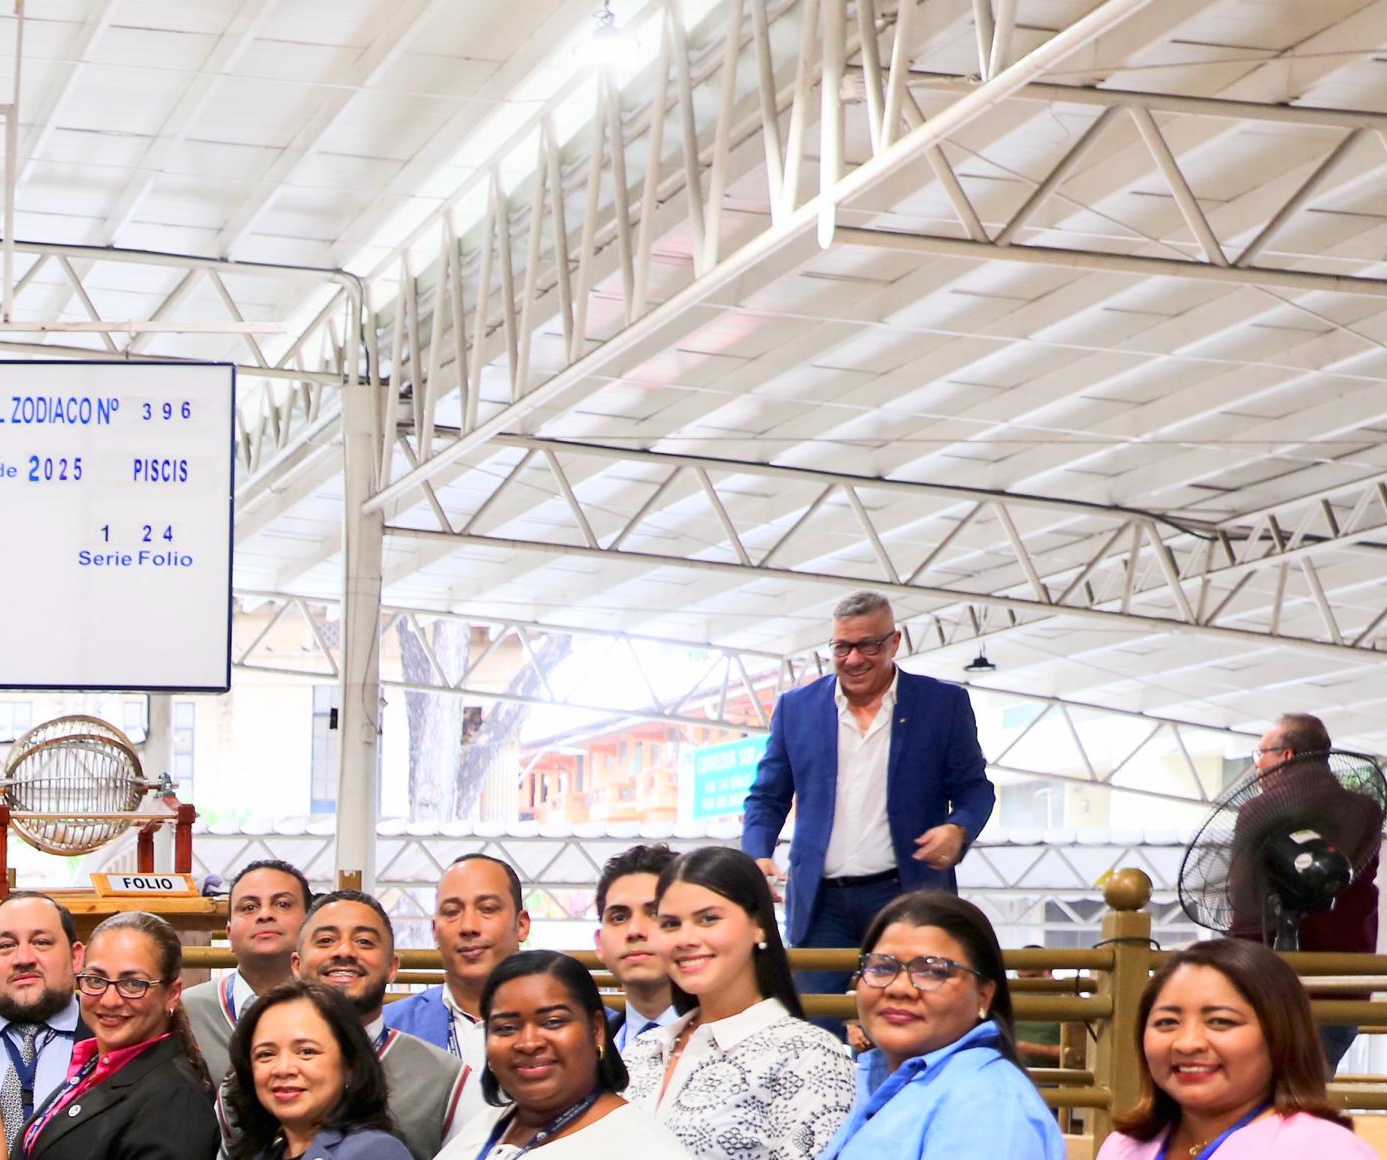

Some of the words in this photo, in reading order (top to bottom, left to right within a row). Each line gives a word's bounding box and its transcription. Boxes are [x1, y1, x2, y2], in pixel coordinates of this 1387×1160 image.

[11, 397, 91, 424] ZODIACO
[29, 456, 82, 481] 2025
[134, 459, 187, 482] PISCIS
[79, 551, 132, 566] Serie
[139, 551, 192, 566] Folio
[123, 878, 172, 889] FOLIO
